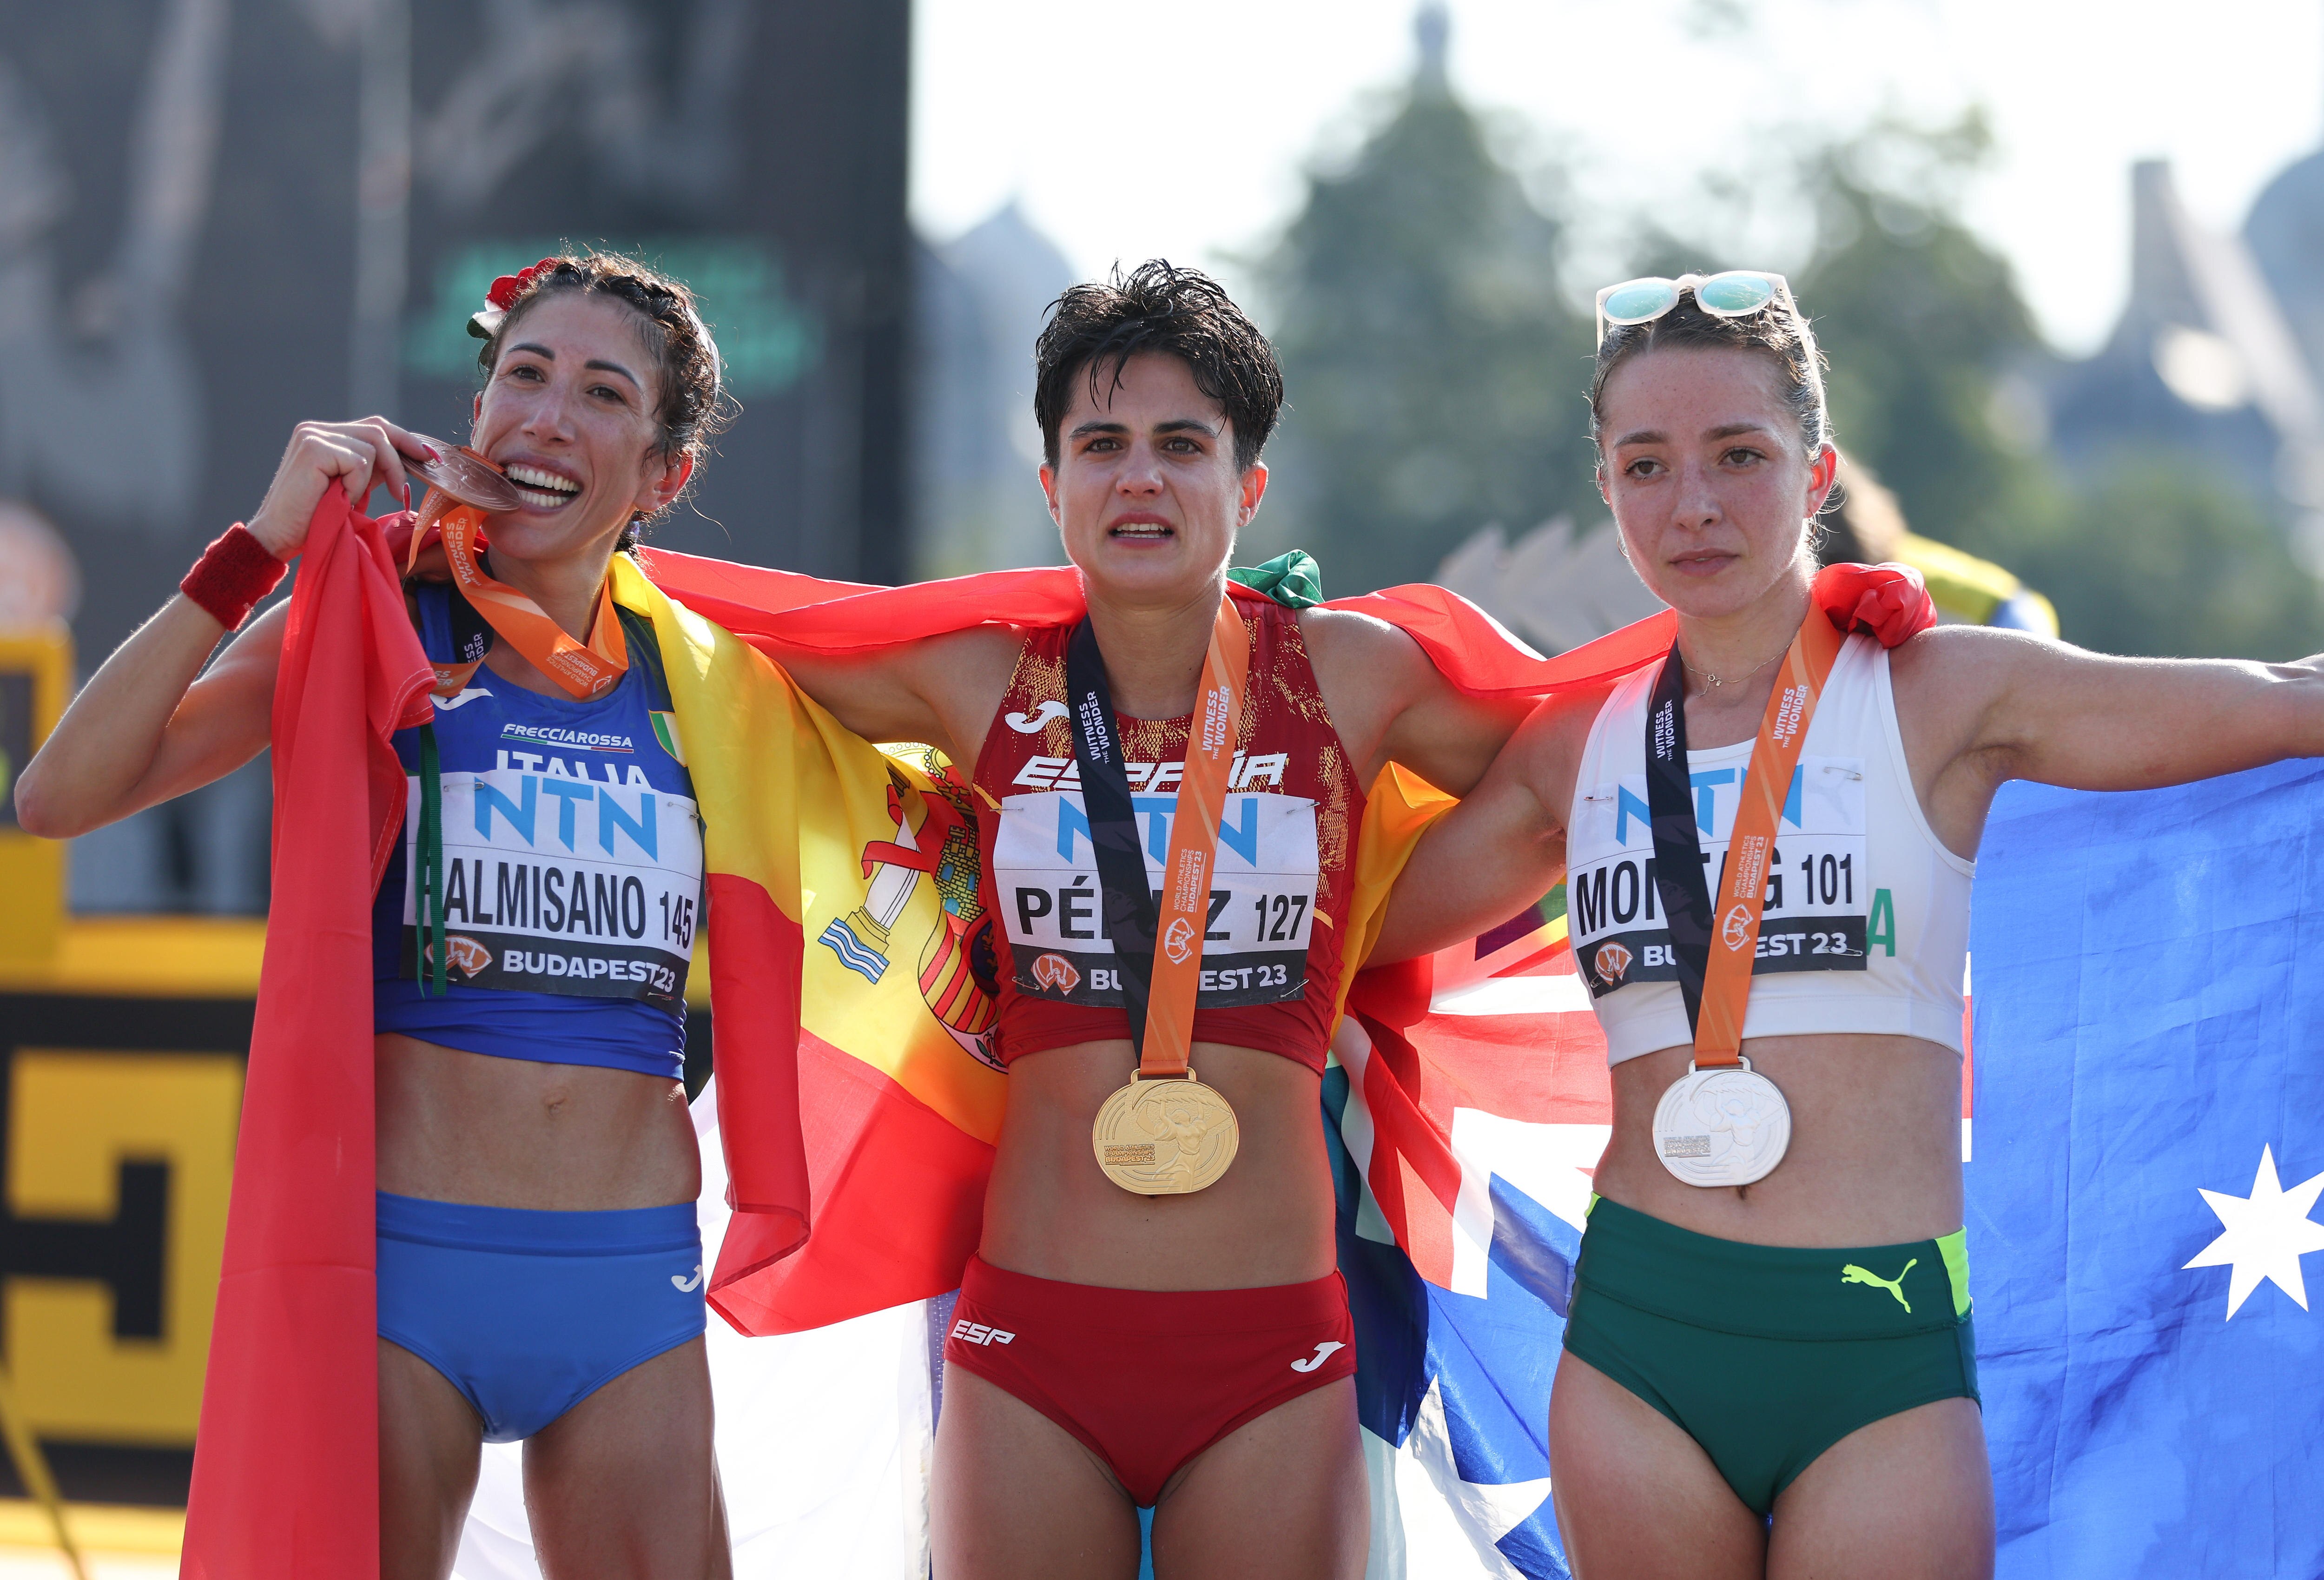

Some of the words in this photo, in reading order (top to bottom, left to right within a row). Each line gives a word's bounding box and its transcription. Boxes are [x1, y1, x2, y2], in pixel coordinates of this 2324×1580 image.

[447, 522, 471, 583] WITNESS
[456, 518, 474, 575] WONDER
[546, 656, 572, 675] ATHLETICS
[551, 653, 593, 682] CHAMPIONSHIPS
[564, 654, 597, 676] BUDAPEST
[571, 674, 588, 688] WORLD
[503, 724, 633, 747] FRECCIAROSSA
[1079, 703, 1101, 760] WITNESS
[1087, 691, 1110, 749] WONDER
[1202, 690, 1218, 751] WITNESS
[1215, 686, 1230, 745] WONDER
[1656, 711, 1665, 759] WITNESS
[1665, 700, 1675, 748] WONDER
[1773, 688, 1795, 740] WITNESS
[1786, 685, 1808, 734] WONDER
[475, 776, 658, 862] NTN
[1177, 848, 1188, 884] ATHLETICS
[1180, 850, 1194, 912] CHAMPIONSHIPS
[1187, 863, 1200, 912] BUDAPEST
[1195, 851, 1202, 862] 23
[1733, 873, 1742, 897] WORLD
[1738, 835, 1750, 871] ATHLETICS
[1740, 836, 1756, 898] CHAMPIONSHIPS
[1746, 849, 1761, 898] BUDAPEST
[1756, 837, 1764, 847] 23
[1802, 853, 1852, 905] 101
[416, 858, 646, 939] ALMISANO
[660, 891, 693, 949] 145
[1016, 876, 1231, 940] PÉZ
[1255, 894, 1308, 942] 127
[1174, 886, 1182, 910] WORLD
[503, 950, 660, 985] BUDAPEST
[1643, 933, 1806, 966] BUEST
[1811, 932, 1847, 954] 23
[1090, 967, 1253, 991] BUEST
[1256, 964, 1287, 988] 23
[951, 1319, 1016, 1346] ESP
